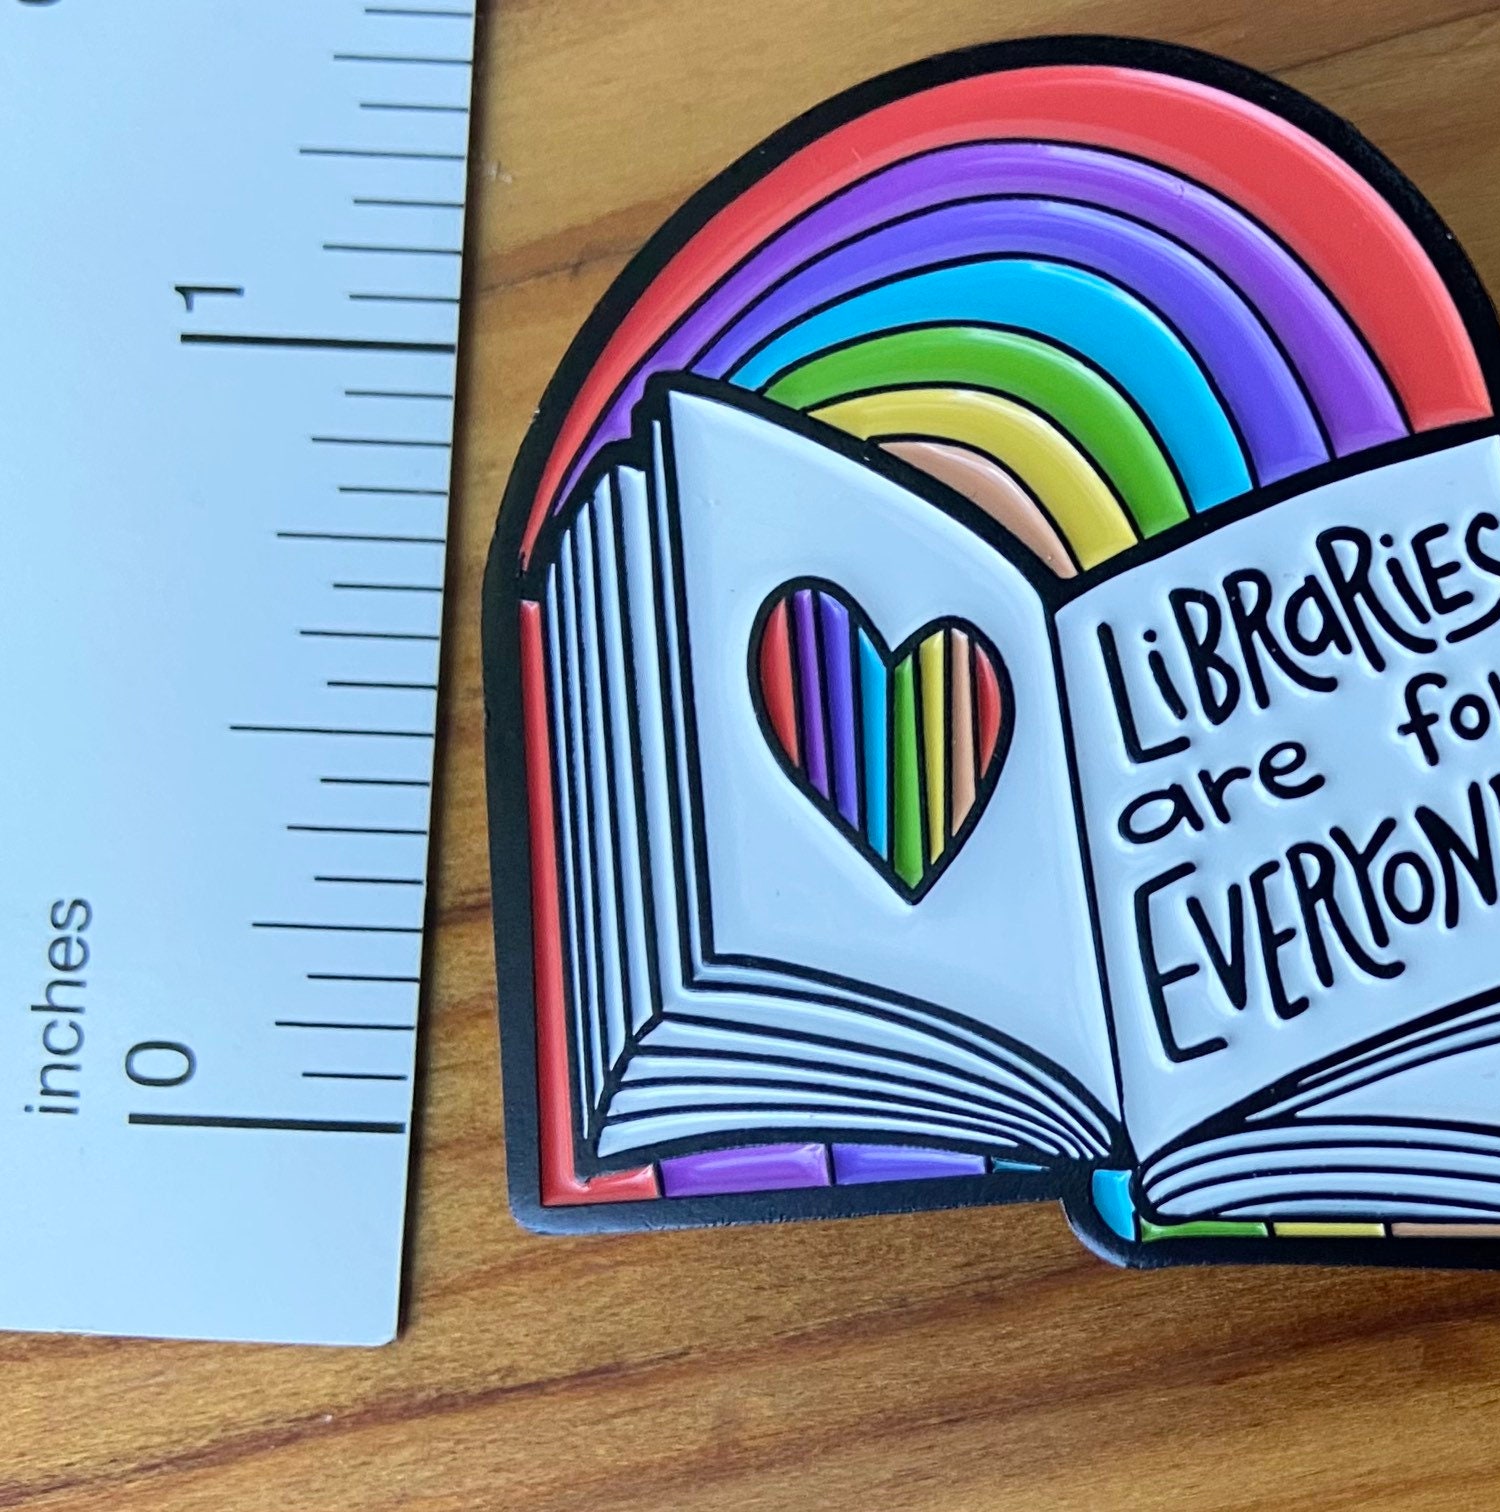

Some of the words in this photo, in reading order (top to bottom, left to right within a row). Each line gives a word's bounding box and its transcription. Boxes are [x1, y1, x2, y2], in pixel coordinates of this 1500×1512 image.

[173, 282, 245, 314] 1
[1117, 740, 1326, 845] are
[23, 897, 93, 1116] inches
